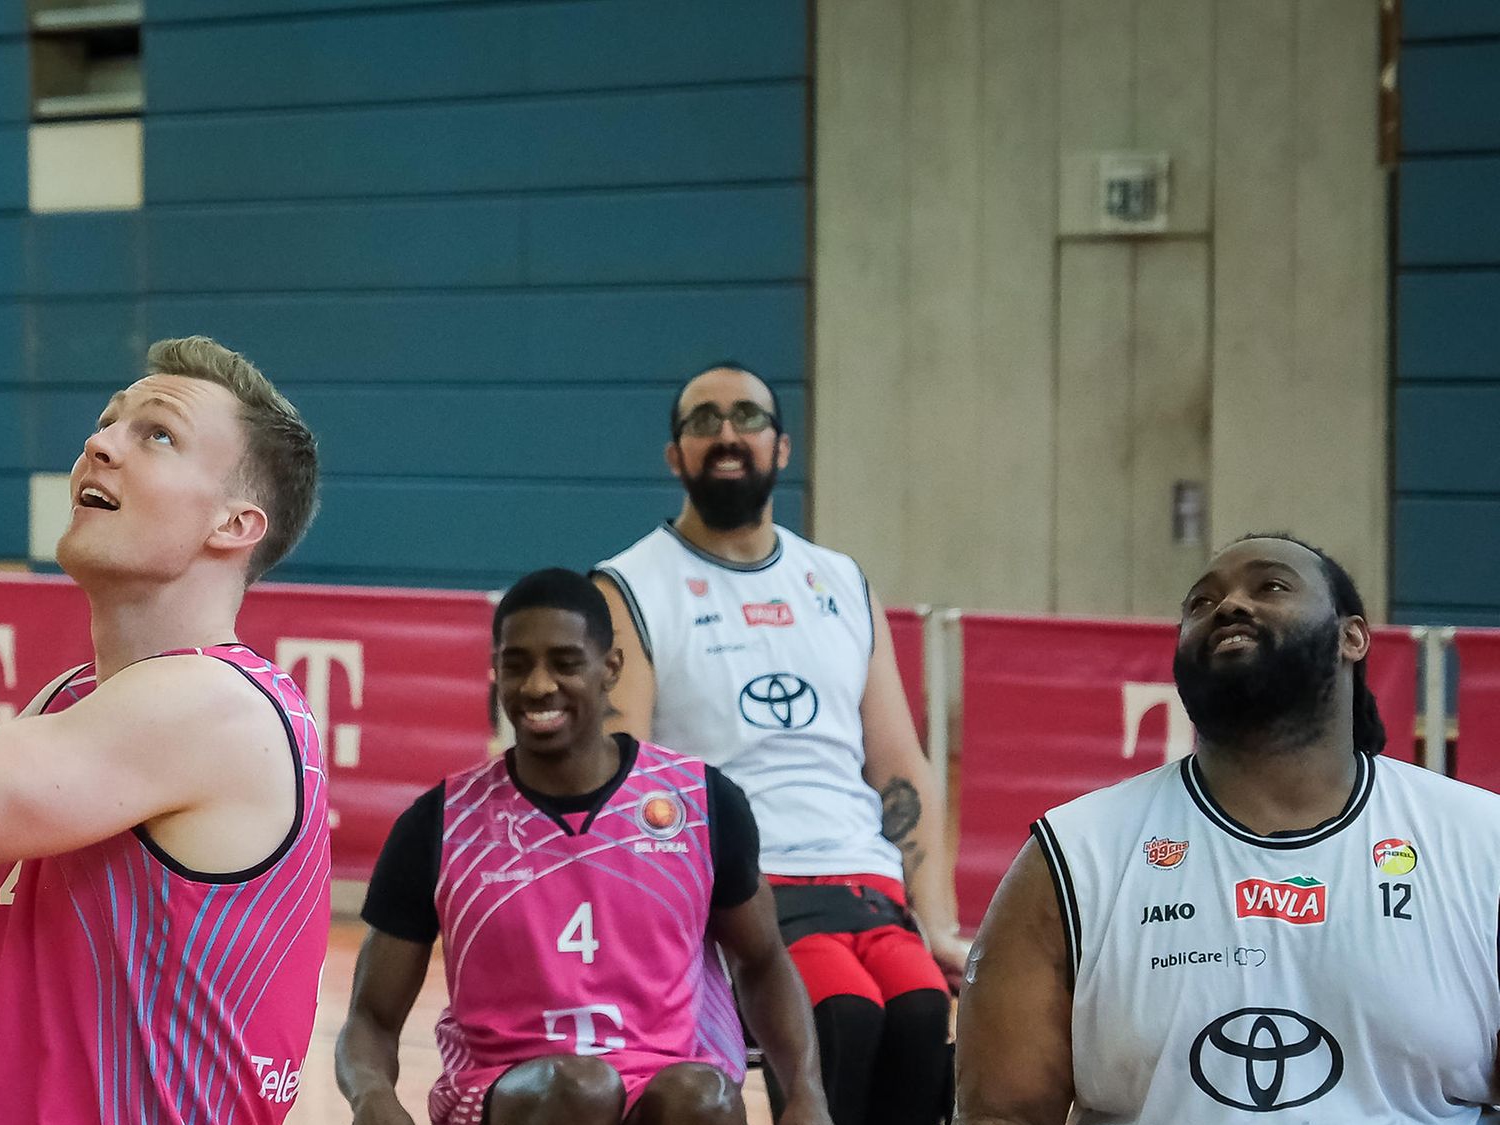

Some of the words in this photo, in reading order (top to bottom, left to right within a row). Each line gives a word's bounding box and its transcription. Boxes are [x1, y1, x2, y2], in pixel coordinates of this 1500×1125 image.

[1140, 903, 1195, 926] JAKO
[1243, 885, 1319, 917] YAYLA
[1378, 882, 1412, 921] 12
[557, 901, 600, 965] 4
[1151, 950, 1222, 969] PubliCare
